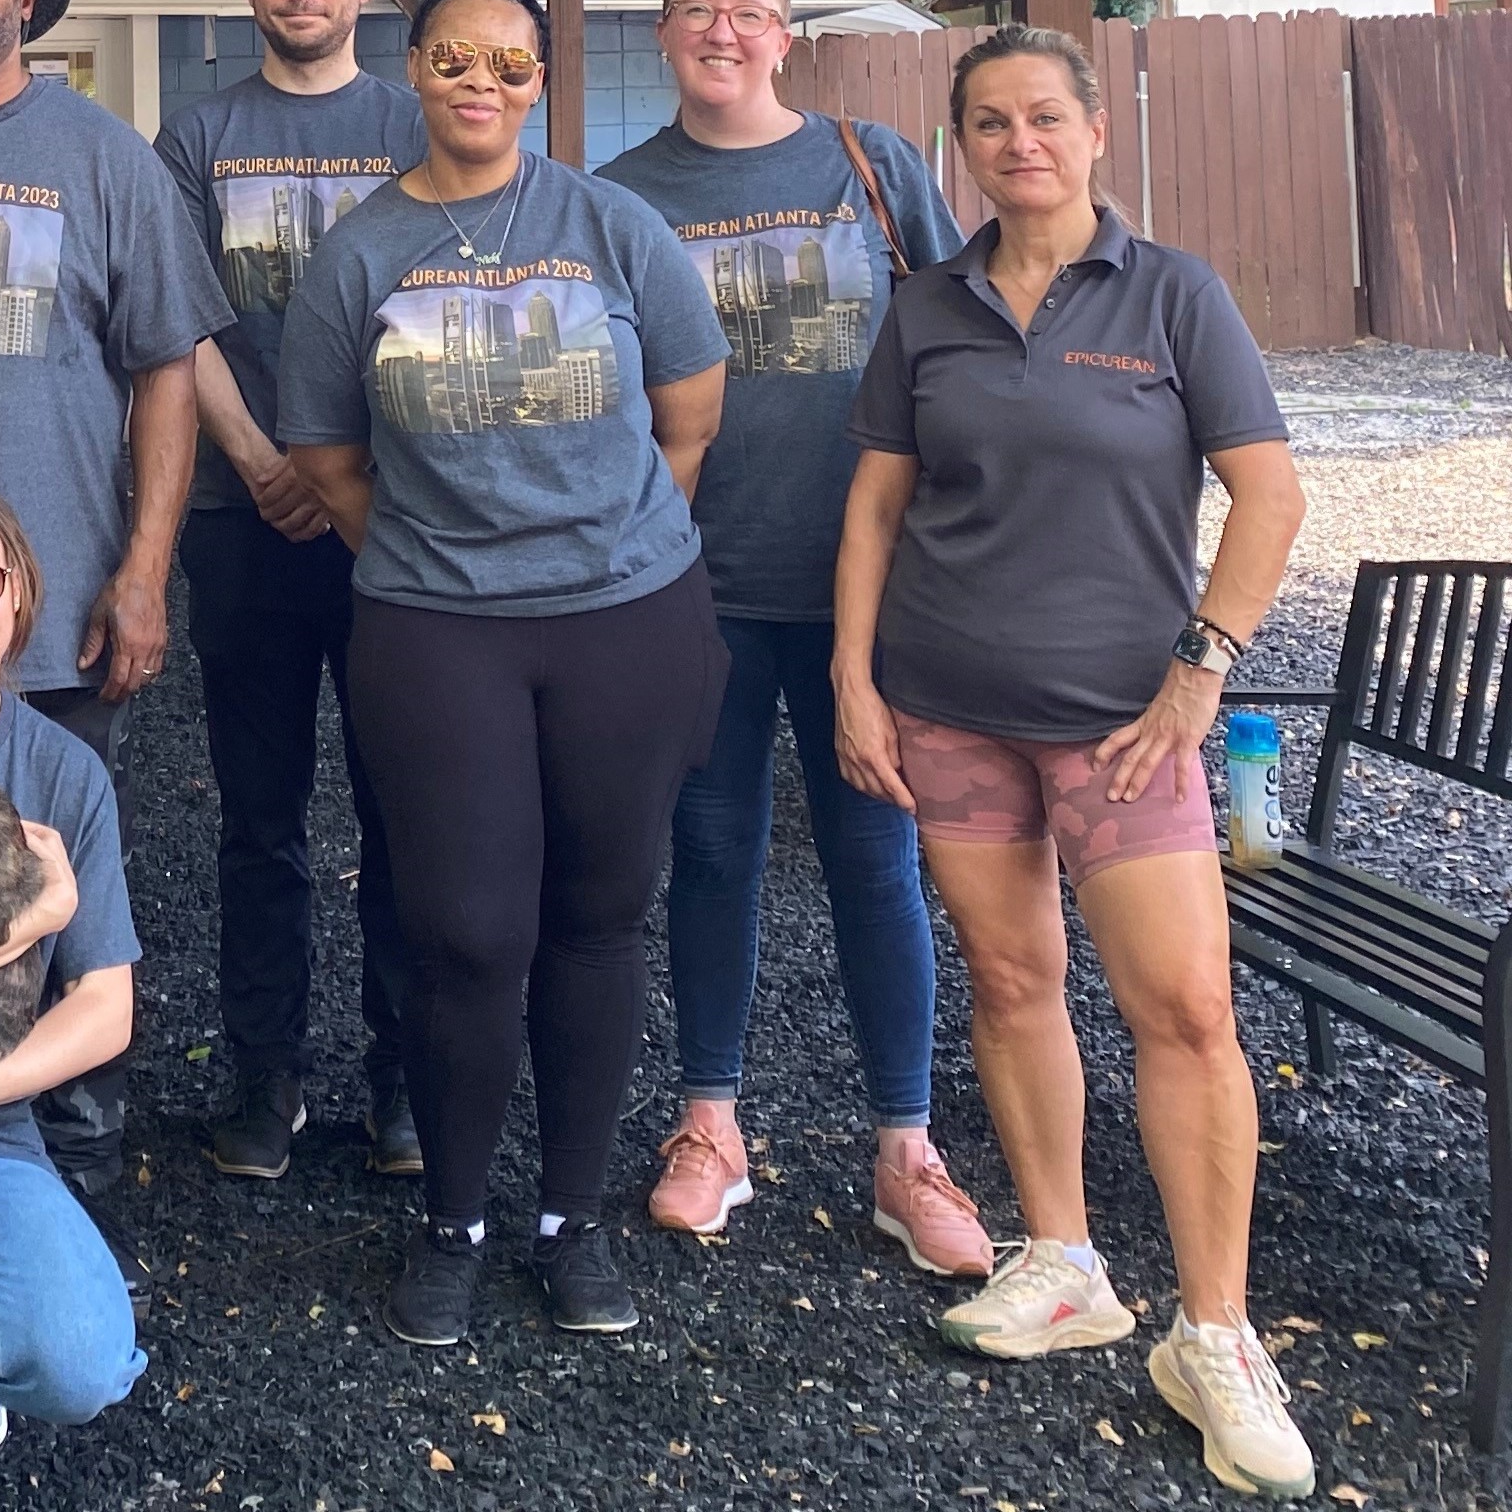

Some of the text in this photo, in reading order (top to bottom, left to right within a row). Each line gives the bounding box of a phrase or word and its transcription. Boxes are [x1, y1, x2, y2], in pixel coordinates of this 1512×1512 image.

[214, 156, 399, 178] EPICUREAN ATLANTA 202
[20, 186, 59, 209] 2023
[744, 209, 821, 231] ATLANTA
[474, 259, 549, 286] ATLANTA
[551, 258, 593, 282] 2023
[1064, 351, 1156, 374] EPICUREAN
[1265, 764, 1281, 839] core
